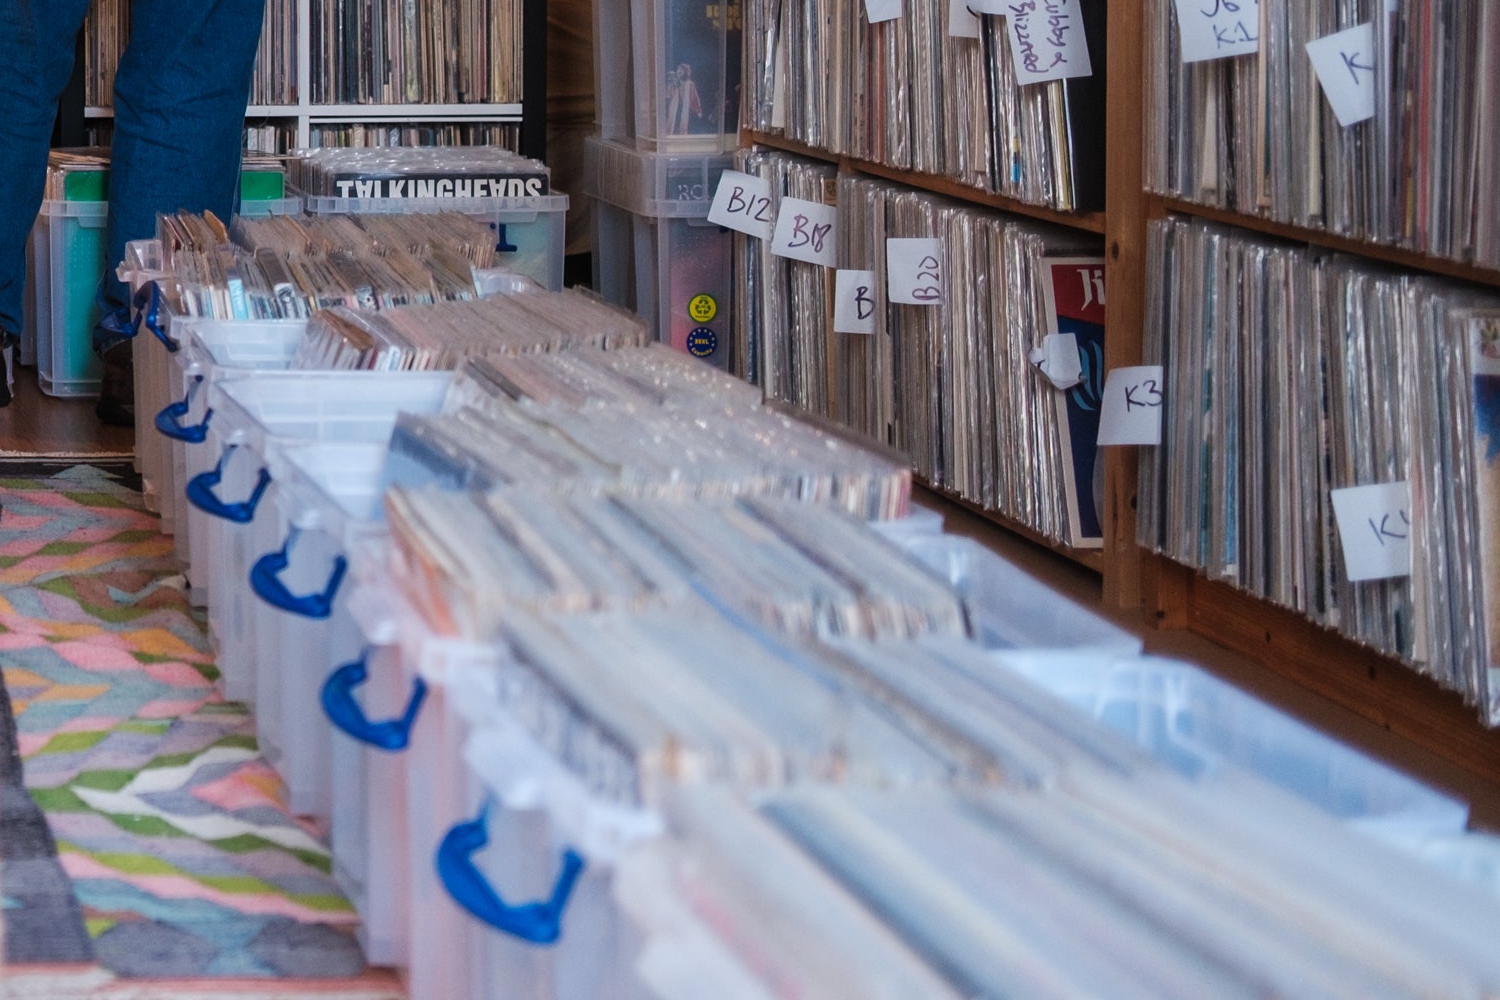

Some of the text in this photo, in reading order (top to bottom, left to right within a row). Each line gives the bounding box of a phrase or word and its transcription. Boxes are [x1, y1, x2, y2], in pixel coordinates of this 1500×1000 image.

[1212, 21, 1258, 50] K1
[727, 186, 770, 222] B12
[788, 214, 832, 253] B18
[912, 256, 941, 301] B20
[1124, 379, 1163, 412] K3
